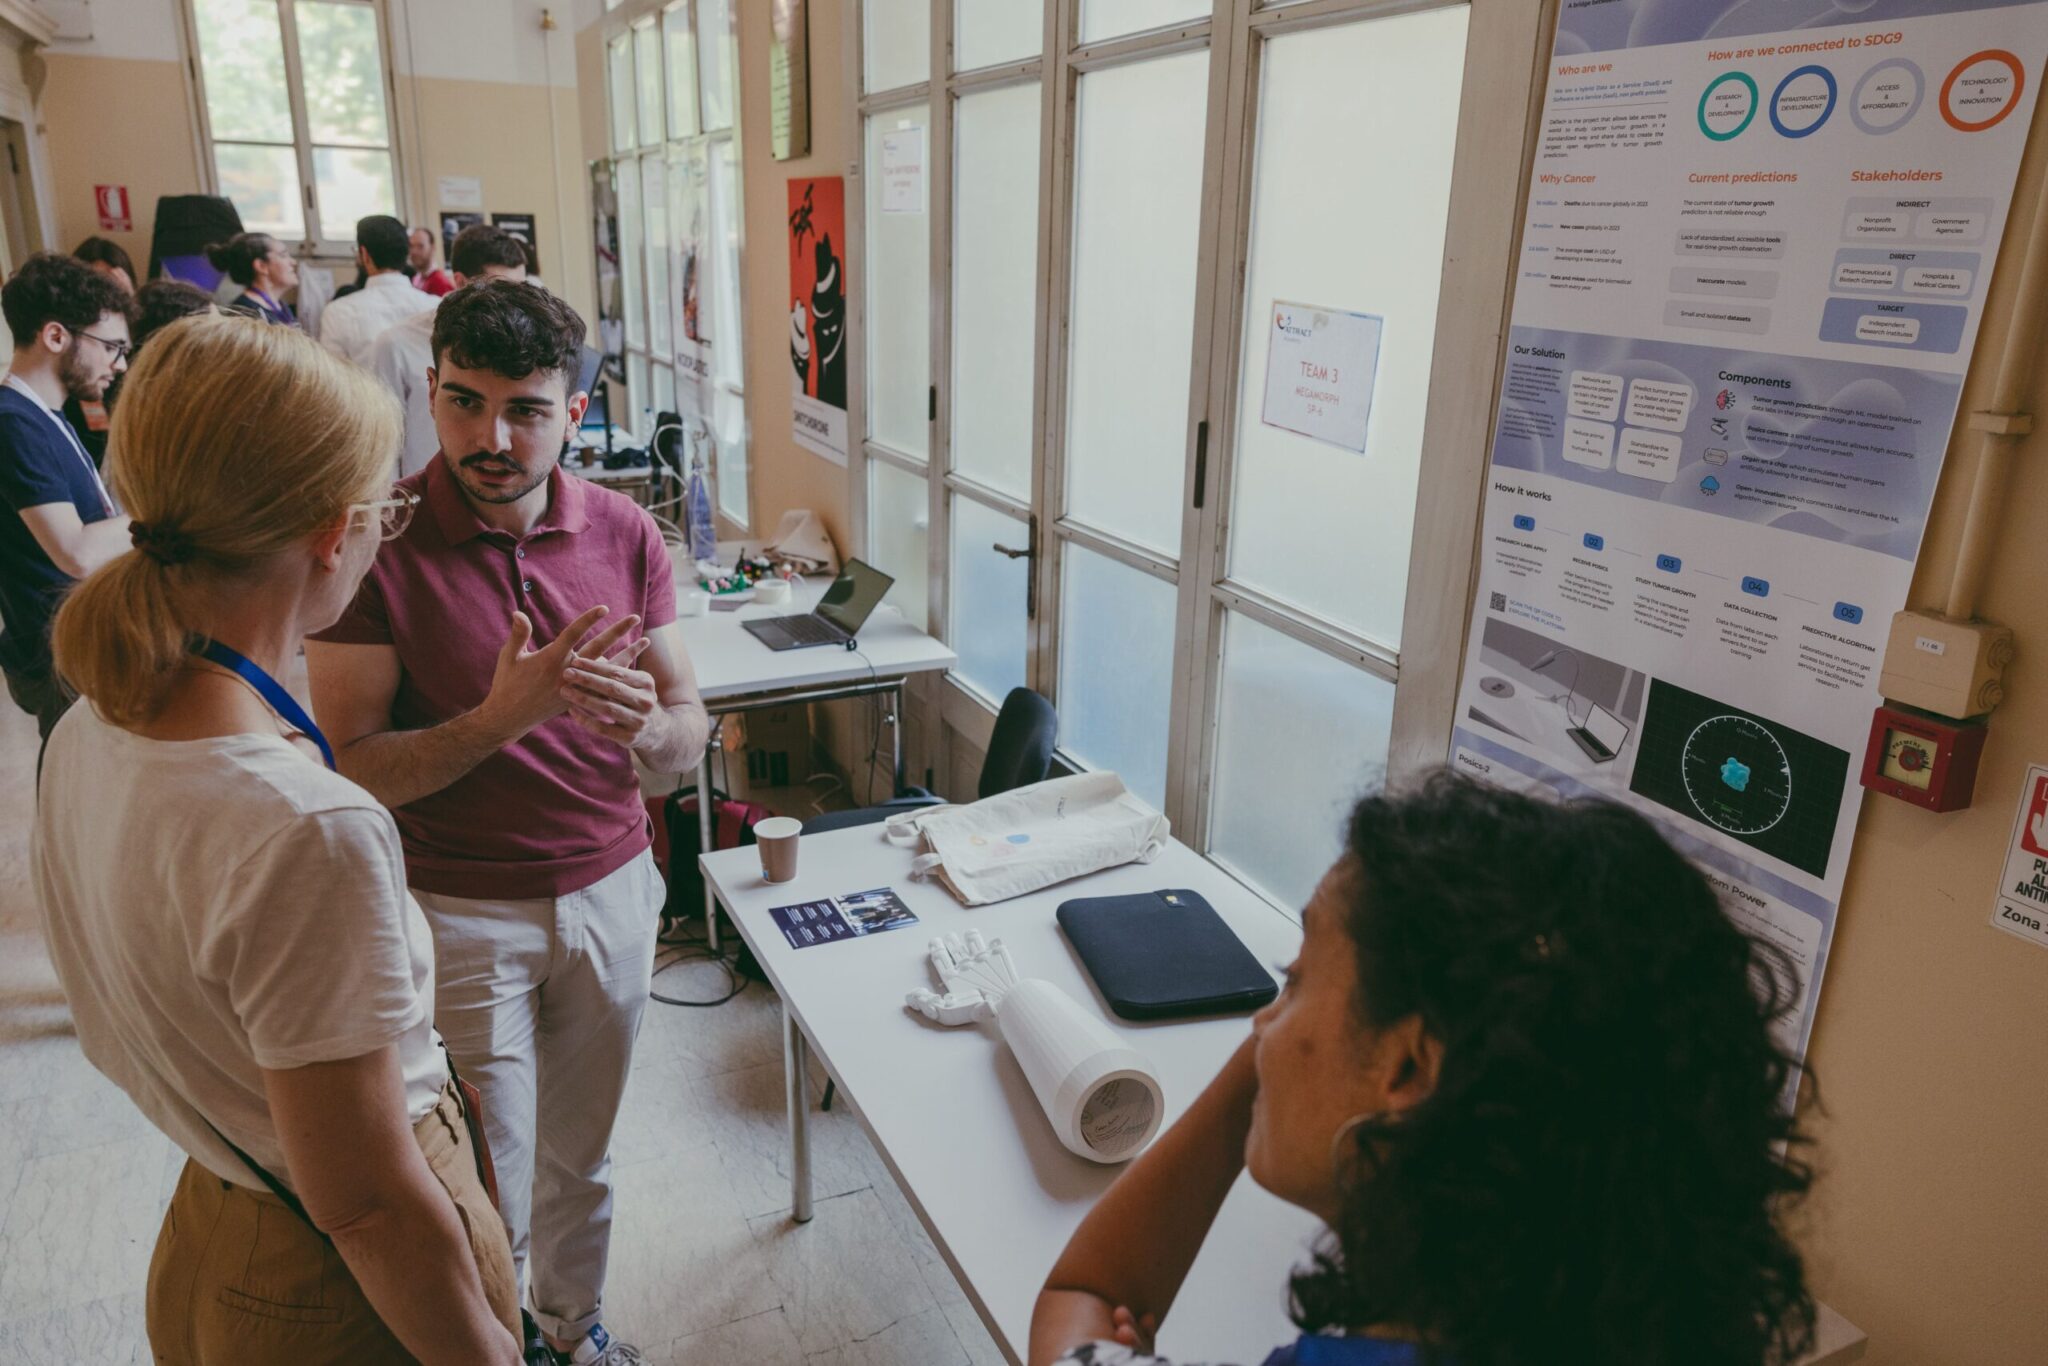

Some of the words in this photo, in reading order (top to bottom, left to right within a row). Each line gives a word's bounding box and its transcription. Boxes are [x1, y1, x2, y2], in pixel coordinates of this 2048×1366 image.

[1708, 51, 1734, 61] How
[1735, 49, 1755, 59] are
[1757, 47, 1775, 56] we
[1778, 38, 1845, 54] connected
[1848, 38, 1862, 48] to
[1864, 32, 1903, 46] SDG9
[1558, 66, 1580, 75] Who
[1581, 65, 1597, 74] are
[1598, 64, 1613, 72] we
[1961, 77, 2008, 86] TECHNOLOGY
[1780, 94, 1828, 102] INFRASTRUCTURE
[1861, 102, 1909, 110] AFFORDABILITY
[1708, 109, 1745, 117] DEVELOPMENT
[1540, 174, 1562, 185] Why
[1563, 174, 1596, 183] Cancer
[1688, 173, 1730, 183] Current
[1731, 171, 1798, 184] predictions
[1851, 170, 1943, 182] Stakeholders
[1877, 304, 1904, 312] TARGET
[1514, 345, 1530, 354] Our
[1531, 347, 1565, 360] Solution
[1301, 361, 1328, 381] TEAM
[1332, 368, 1338, 384] 3
[1718, 370, 1792, 389] Components
[1296, 386, 1340, 406] MEGAMORPH
[1793, 409, 1821, 421] program
[1821, 416, 1847, 424] through
[1856, 421, 1895, 431] opensource
[1829, 407, 1855, 416] through
[1888, 415, 1912, 424] trained
[1812, 437, 1835, 445] camera
[1870, 445, 1885, 454] high
[1765, 469, 1790, 479] allowing
[1839, 473, 1862, 482] human
[1863, 478, 1885, 487] organs
[1495, 482, 1516, 493] How
[1517, 486, 1524, 495] it
[1526, 490, 1552, 502] works
[1806, 499, 1834, 509] connects
[1834, 504, 1847, 512] labs
[1520, 518, 1529, 528] 01
[1588, 537, 1599, 547] 02
[1662, 558, 1675, 569] 03
[1635, 576, 1652, 585] STUDY
[1652, 582, 1671, 591] TUMOR
[1671, 587, 1696, 598] GROWTH
[1748, 581, 1762, 592] 04
[1724, 602, 1739, 611] DATA
[1740, 607, 1778, 621] COLLECTION
[1841, 607, 1855, 619] 05
[1668, 621, 1687, 630] growth
[1716, 617, 1729, 626] Data
[1729, 622, 1743, 630] from
[1743, 626, 1756, 634] labs
[1720, 637, 1739, 646] servers
[1748, 645, 1767, 654] model
[1802, 625, 1837, 640] PREDICTIVE
[1838, 637, 1876, 652] ALGORITHM
[1799, 643, 1833, 659] Laboratories
[1840, 658, 1860, 668] return
[1798, 662, 1816, 672] service
[1824, 670, 1849, 683] facilitate
[1849, 679, 1864, 688] their
[1800, 654, 1818, 664] access
[1836, 666, 1866, 680] predictive
[1458, 753, 1490, 774] Posics-2
[2032, 874, 2048, 890] AL
[1732, 886, 1767, 909] Power
[2002, 906, 2040, 931] Zona
